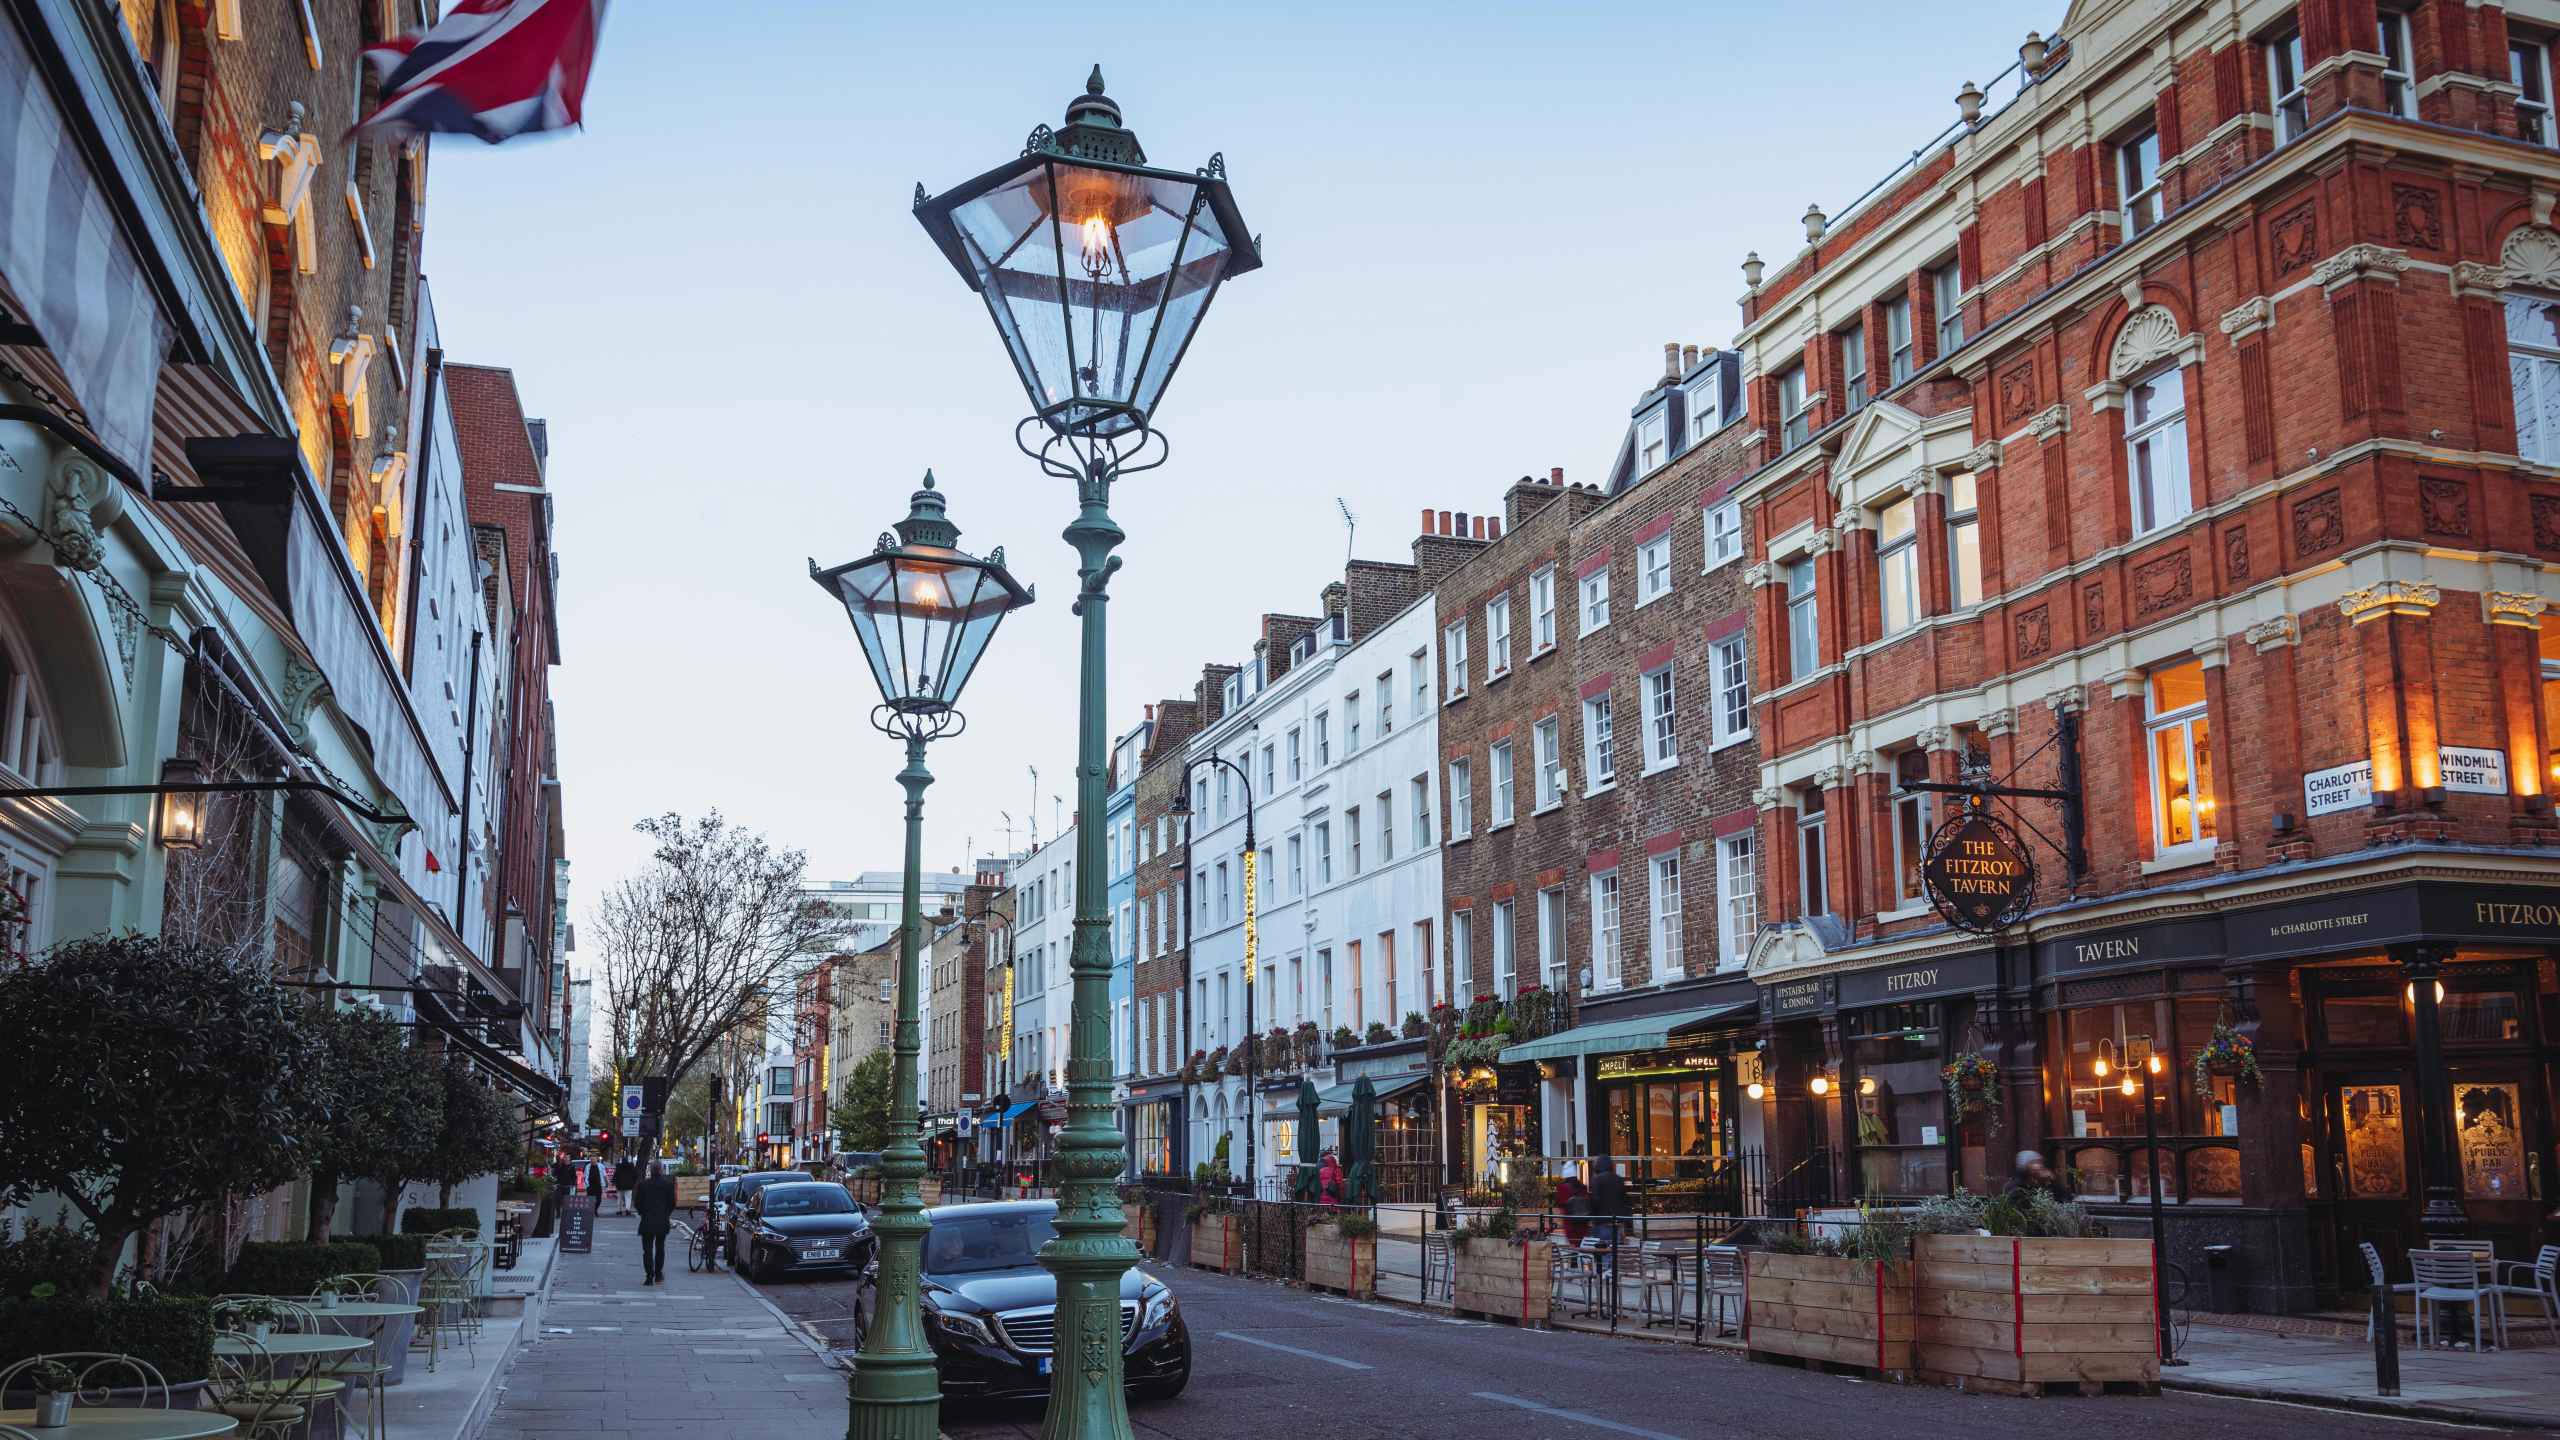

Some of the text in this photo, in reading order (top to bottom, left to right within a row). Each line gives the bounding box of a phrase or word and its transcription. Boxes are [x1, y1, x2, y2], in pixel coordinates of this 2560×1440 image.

[2439, 752, 2498, 769] WINDMILL
[2309, 767, 2373, 792] CHARLOTTE
[2441, 769, 2485, 785] STREET
[2310, 788, 2351, 808] STREET
[1962, 840, 1996, 856] THE
[1945, 858, 2013, 876] FITZROY
[1950, 878, 2011, 895] TAVERN
[2475, 902, 2560, 926] FITZROY
[2280, 918, 2334, 935] CHARLOTTE
[2335, 913, 2369, 928] STREET
[2075, 936, 2140, 963] TAVERN
[1887, 969, 1939, 991] FITZROY
[1777, 982, 1820, 998] UPSTAIRS BAR
[1782, 995, 1814, 1009] & DINING
[1684, 1057, 1718, 1067] AMPELI
[1745, 1057, 1763, 1081] 18
